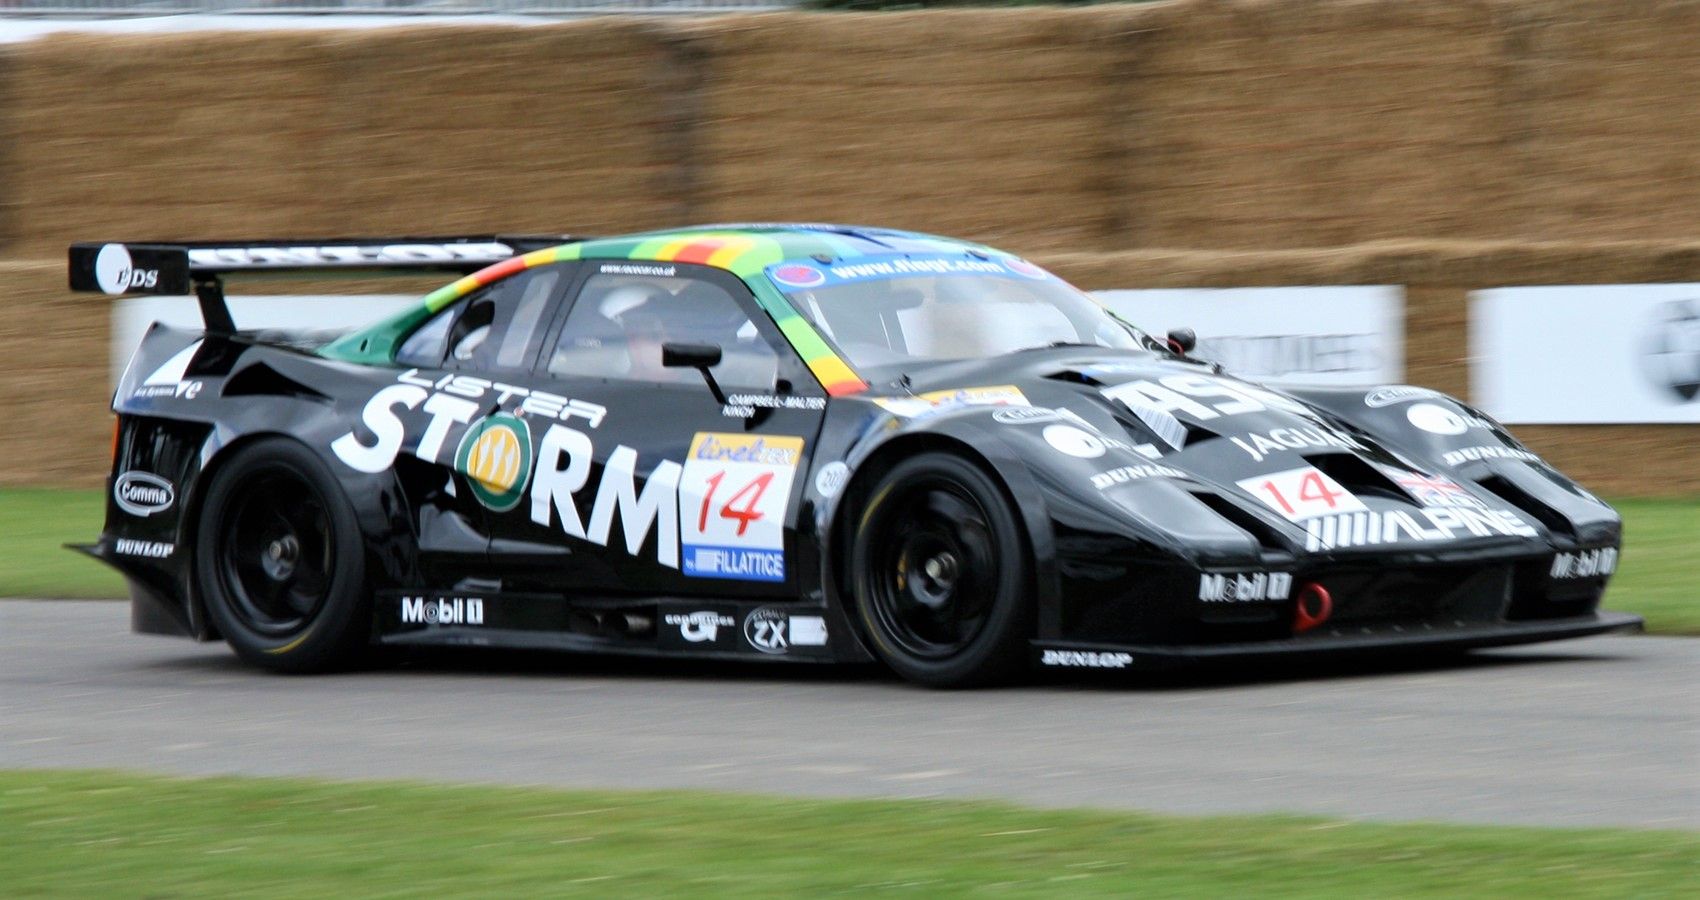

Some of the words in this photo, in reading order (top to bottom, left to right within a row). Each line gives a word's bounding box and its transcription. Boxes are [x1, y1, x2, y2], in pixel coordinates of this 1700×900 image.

[397, 368, 607, 429] LISTER
[121, 480, 167, 504] Comma
[331, 384, 683, 570] STORM
[698, 469, 775, 537] 14
[1259, 469, 1344, 516] 14
[116, 538, 175, 558] DUNLOP
[714, 549, 785, 578] FILLATTICE
[402, 596, 464, 625] Mobil
[753, 619, 788, 649] ZX
